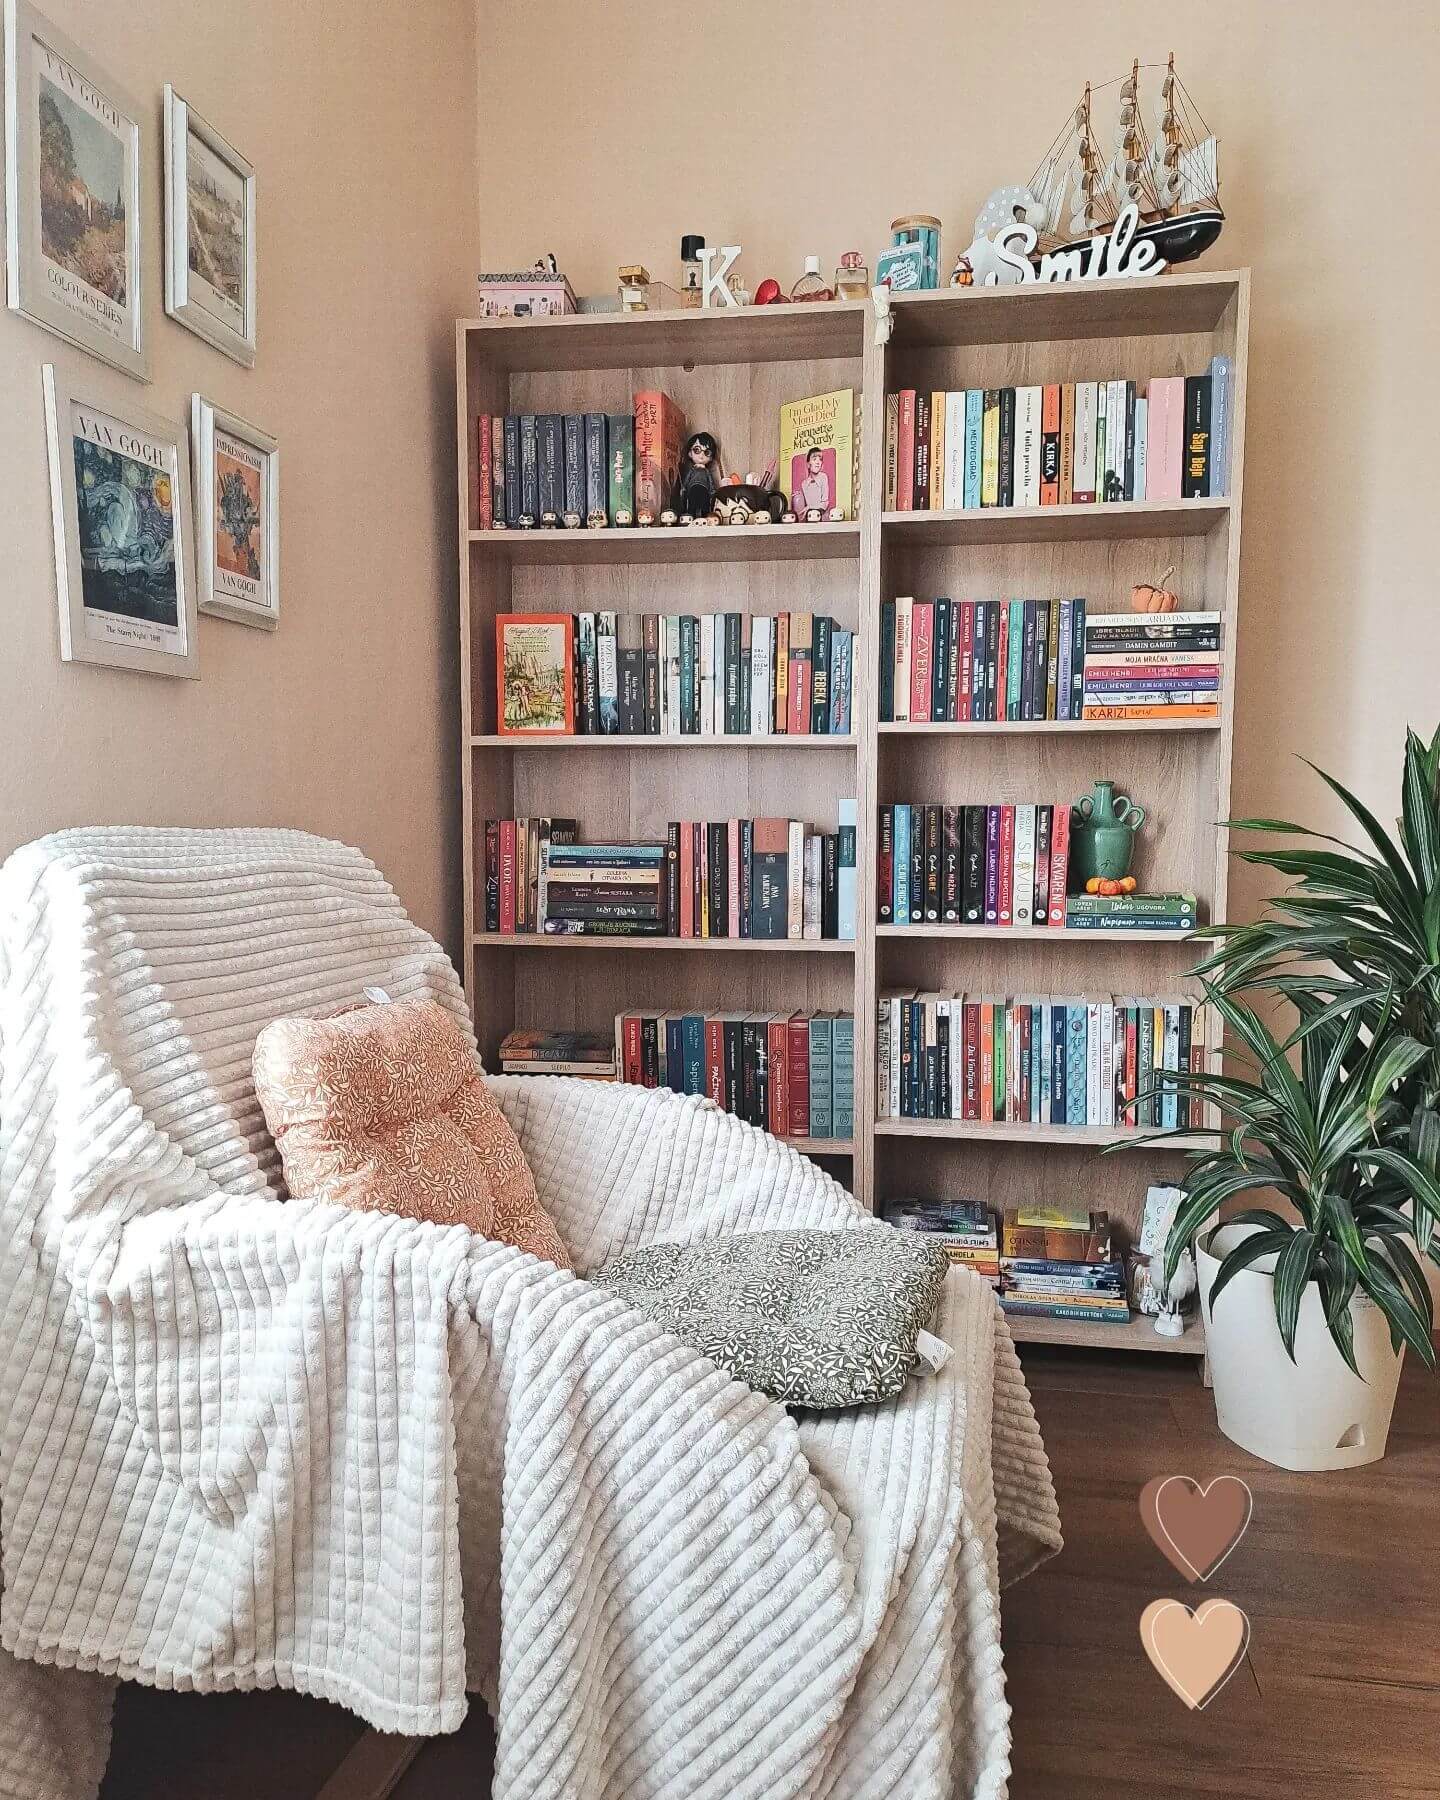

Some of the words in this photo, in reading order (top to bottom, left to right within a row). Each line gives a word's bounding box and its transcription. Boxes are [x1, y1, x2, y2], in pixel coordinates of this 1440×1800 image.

[988, 203, 1168, 286] Smile
[695, 245, 742, 309] K
[789, 408, 802, 418] I'm
[804, 402, 824, 414] Glad
[826, 397, 840, 408] My
[792, 414, 814, 426] Mom
[816, 408, 836, 422] Died
[79, 416, 112, 446] VAN
[120, 434, 164, 467] GOGH
[793, 433, 834, 450] McCurdy
[795, 424, 833, 440] Jennette
[1190, 432, 1208, 452] Šagi
[1046, 443, 1056, 476] KIRKA
[1191, 457, 1206, 477] Bejn
[221, 572, 236, 590] VAN
[238, 576, 257, 595] GOGH
[106, 625, 116, 634] The
[916, 636, 928, 678] ZVER
[814, 671, 827, 704] REBEKA
[1090, 708, 1126, 719] KARIZI
[503, 854, 512, 883] DVOR
[970, 873, 978, 888] LAŽI
[1016, 842, 1031, 902] SLAVUJ
[1052, 854, 1065, 904] ISKVARENI
[898, 863, 907, 906] SLAVLJENICA
[948, 873, 956, 901] MRŽNJA
[689, 1061, 700, 1095] Sapijen
[711, 1066, 722, 1105] PAČINKO
[1050, 1277, 1070, 1285] Central
